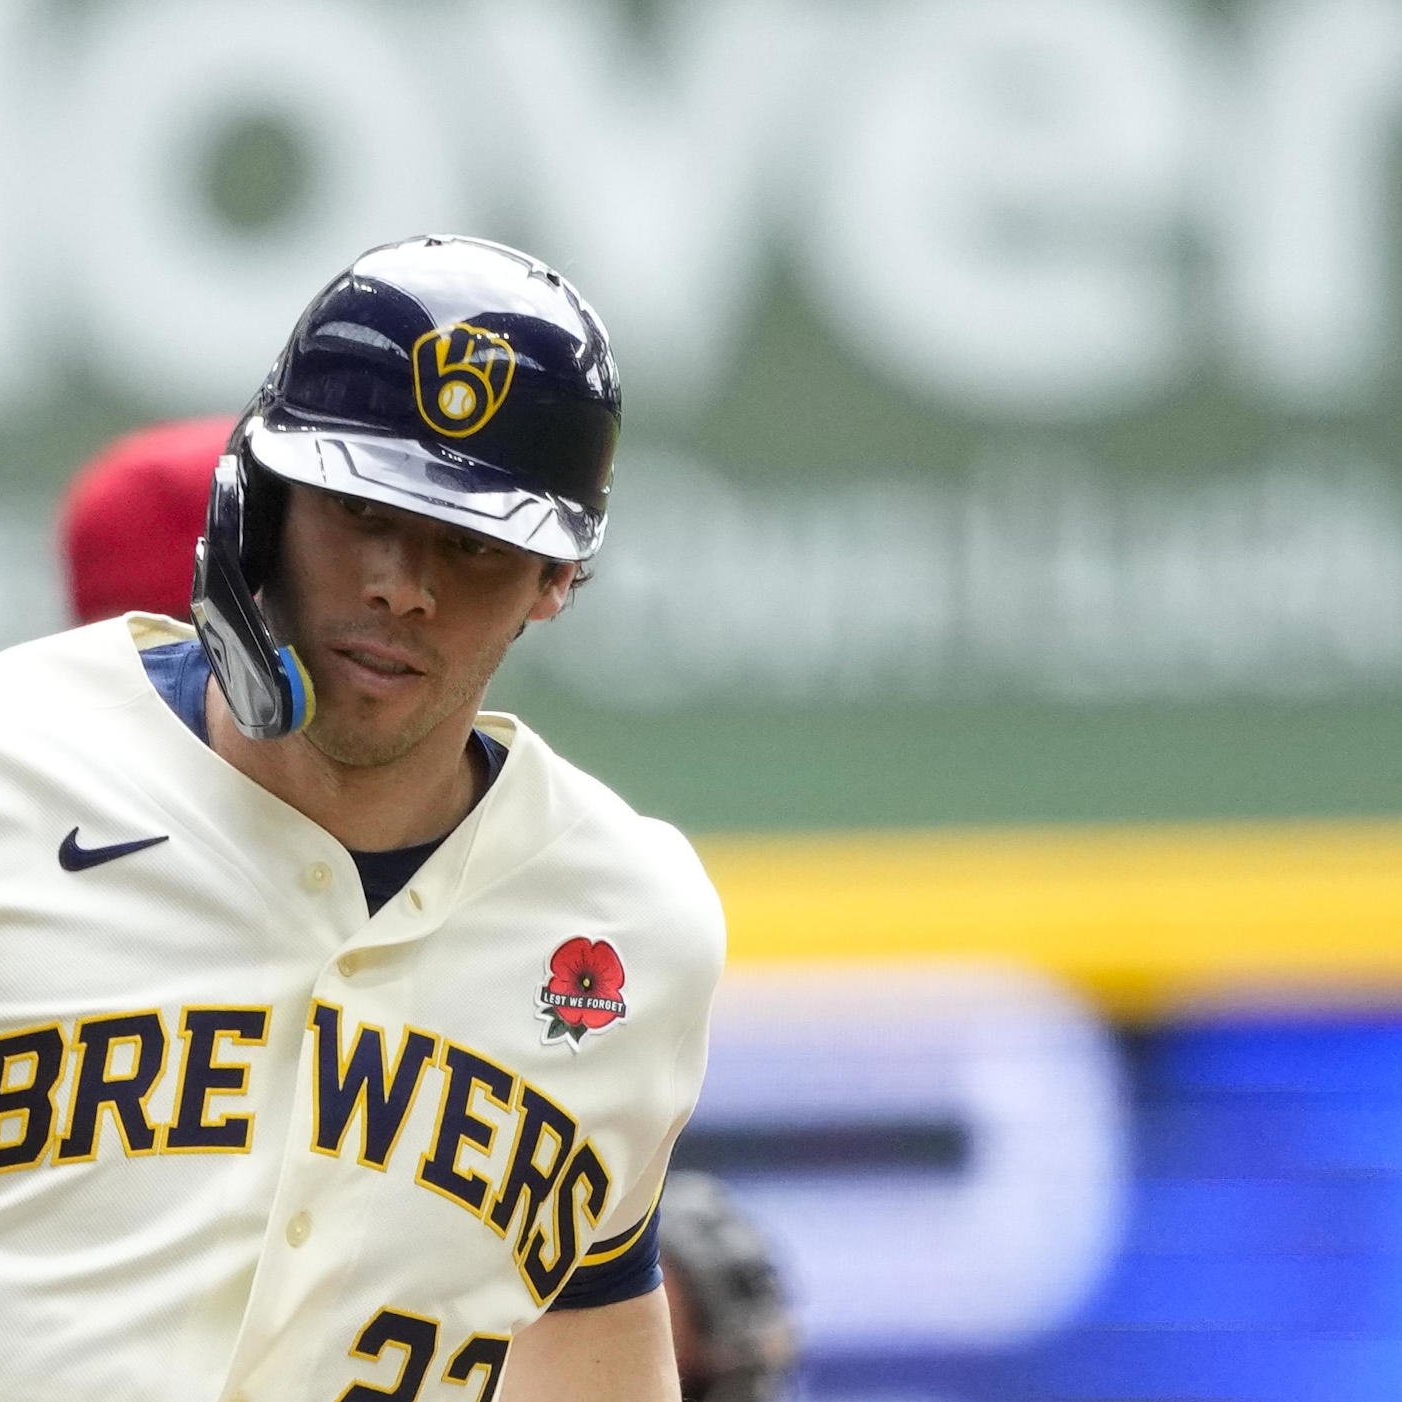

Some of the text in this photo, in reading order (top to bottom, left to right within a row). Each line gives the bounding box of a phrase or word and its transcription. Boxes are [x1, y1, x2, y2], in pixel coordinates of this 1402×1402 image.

[543, 992, 624, 1014] LEST WE FORGET
